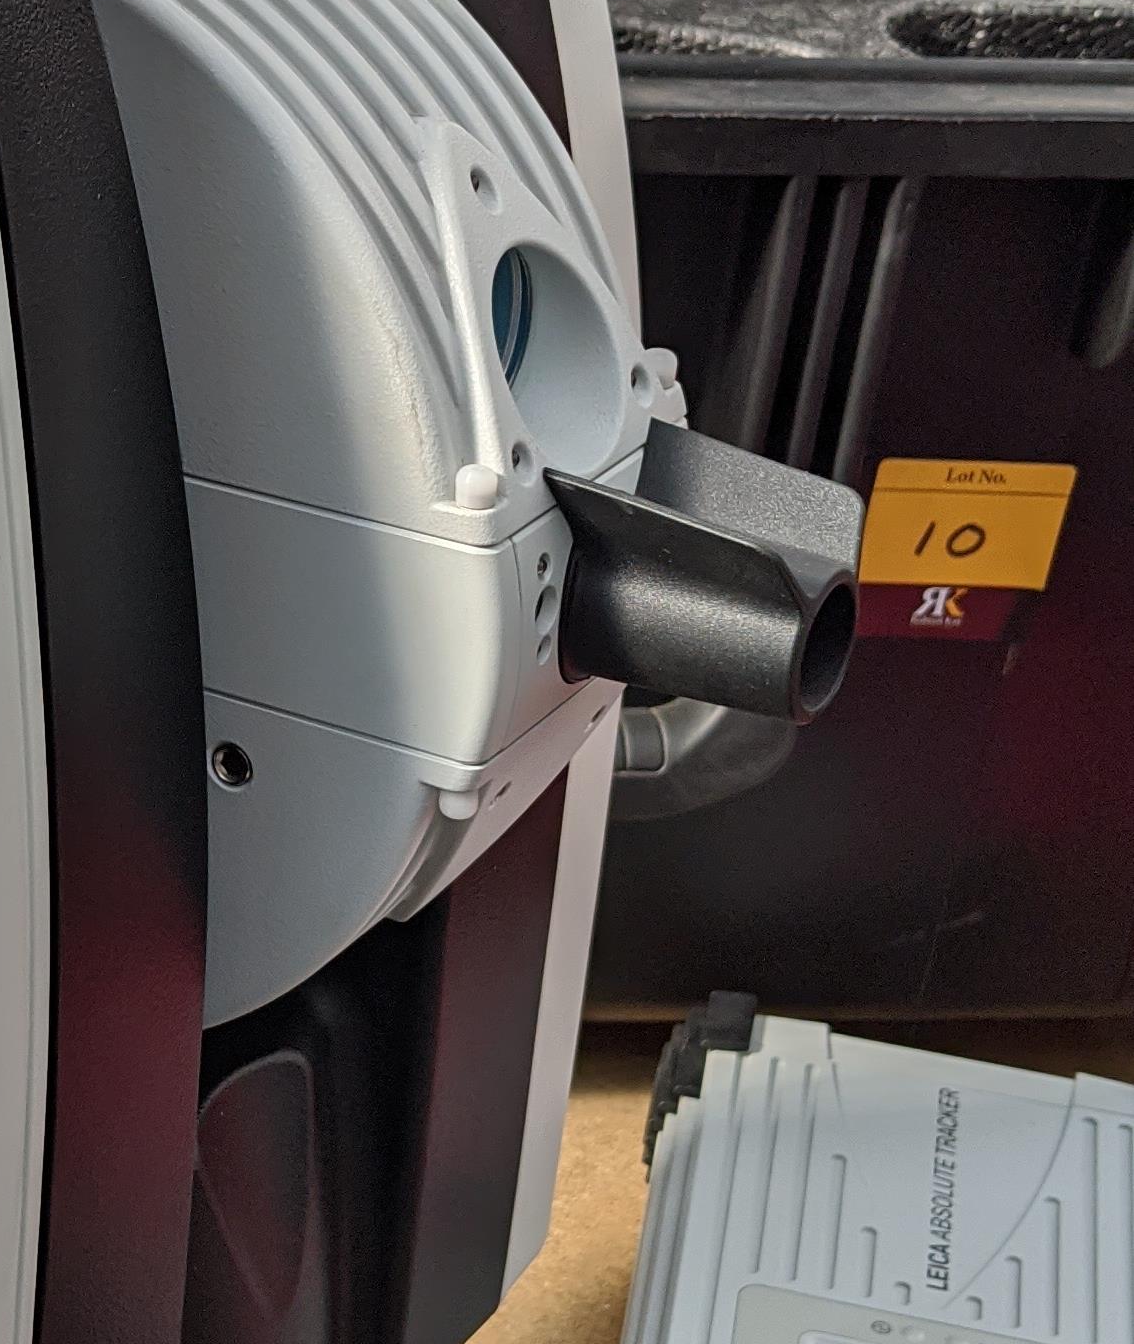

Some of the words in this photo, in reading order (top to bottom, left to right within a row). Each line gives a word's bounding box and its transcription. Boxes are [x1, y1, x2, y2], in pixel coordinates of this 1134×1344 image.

[946, 467, 975, 483] Lot
[977, 469, 1007, 484] No.
[914, 521, 986, 558] 10
[934, 1087, 960, 1156] TRACKER
[929, 1156, 956, 1243] ABSOLUTE
[926, 1243, 951, 1292] LEICA
